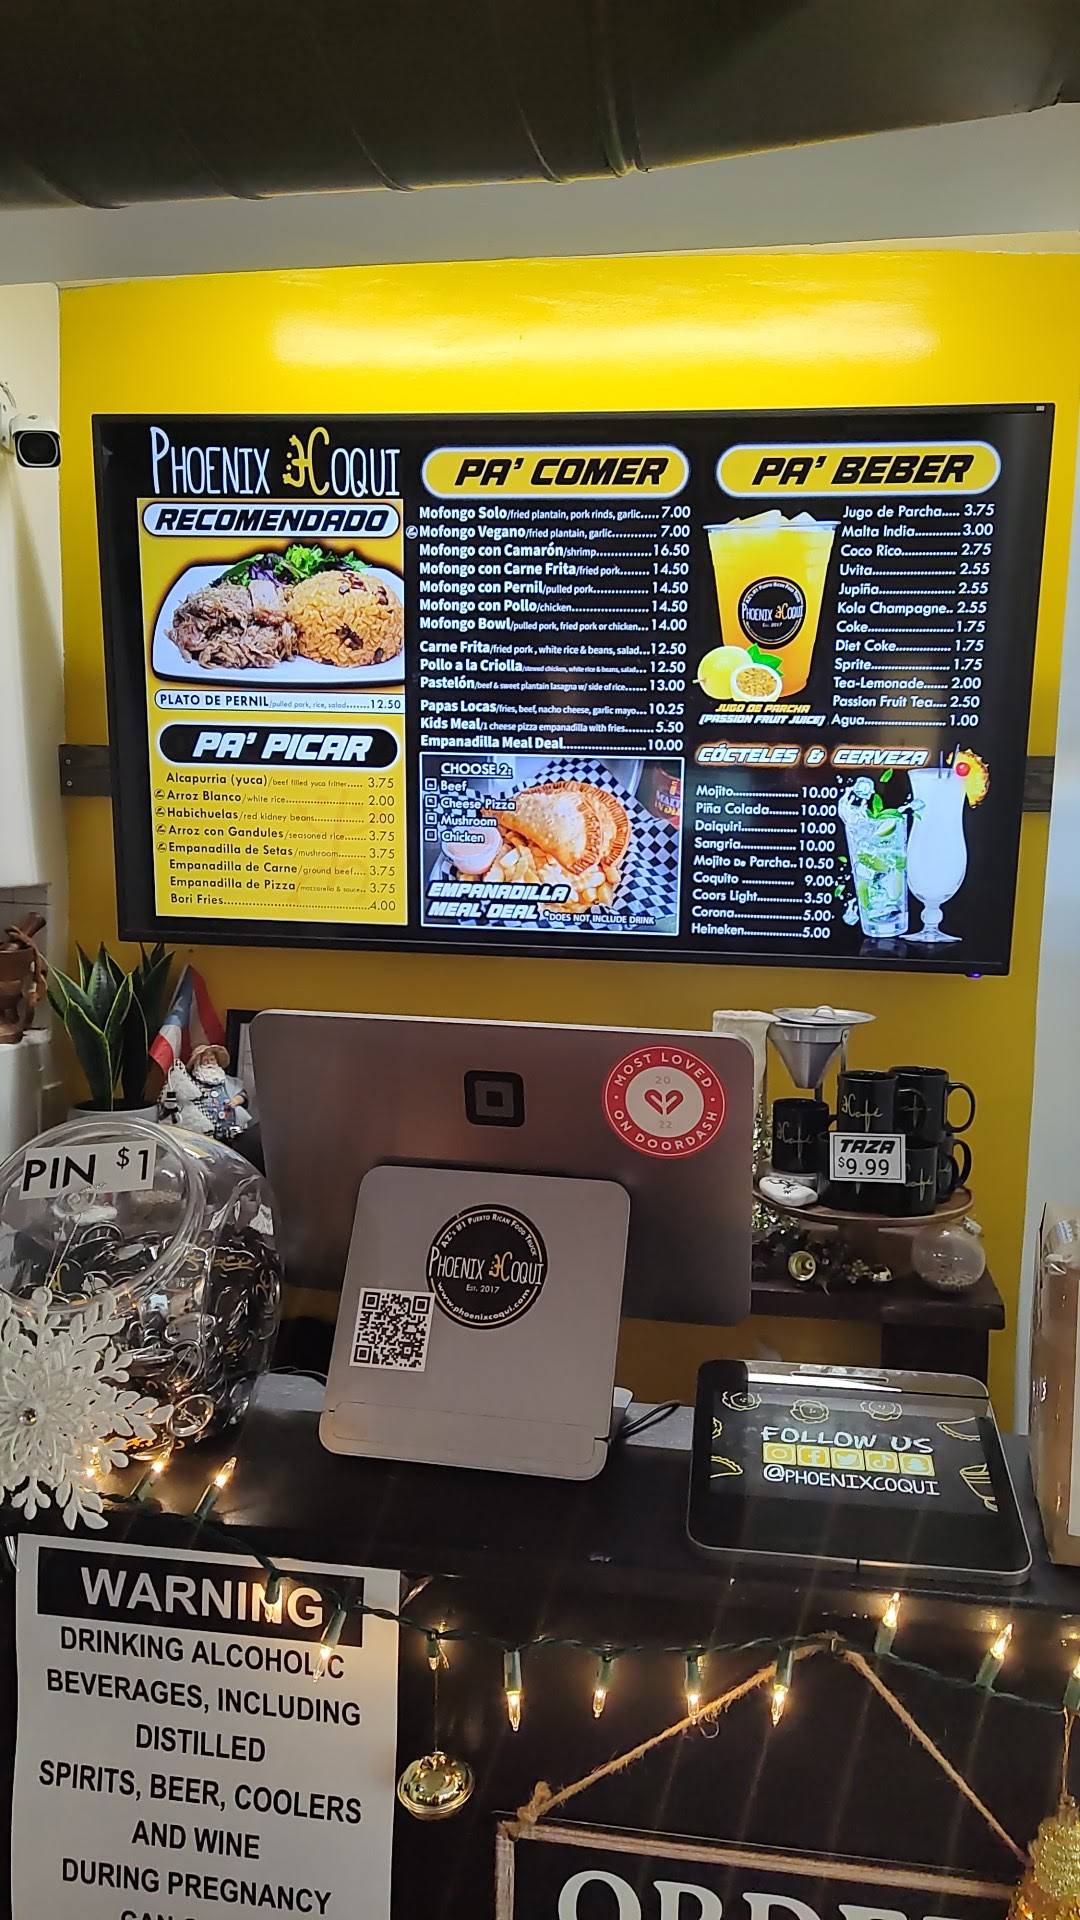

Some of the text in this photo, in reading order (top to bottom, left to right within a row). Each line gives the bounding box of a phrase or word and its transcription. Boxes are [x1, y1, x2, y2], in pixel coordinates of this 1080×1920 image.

[150, 426, 270, 494] PHOENIX
[455, 458, 669, 486] PA' COMER
[752, 455, 974, 485] PA' BEBER
[420, 506, 690, 521] Mofongo plantain, pork rinds, 7.00
[843, 504, 994, 519] Jugo de 3.75
[155, 509, 389, 531] RECOMENDADO
[420, 526, 690, 540] Mofongo plantain, 7.00
[841, 524, 993, 537] Malta 3.00
[420, 544, 501, 558] Mofongo con
[841, 543, 991, 556] Coco 2.75
[420, 563, 688, 577] Mofongo con Carne 14.50
[960, 563, 990, 574] 2.55
[420, 581, 688, 595] Mofongo con 14.50
[958, 582, 988, 594] 2.55
[420, 600, 687, 614] Mofongo con 14.50
[838, 602, 987, 614] Kola 2.55
[420, 617, 687, 631] Mofongo pork, fried pork 14.00
[956, 621, 985, 633] 1.75
[420, 641, 615, 655] Carne white rice beans,
[835, 640, 984, 651] Diet 1.75
[421, 659, 685, 672] Pollo la 12.50
[953, 659, 982, 670] 1.75
[500, 680, 685, 691] sweet plantain lasagna 13.00
[951, 677, 981, 689] 2.00
[160, 695, 221, 705] PLATO DE
[833, 695, 980, 708] Passion Fruit 2.50
[421, 701, 684, 715] Papas nacho cheese, 10.25
[421, 718, 587, 732] Kids cheese pizza empanadilla
[193, 732, 373, 761] PA' PICAR
[421, 735, 683, 750] Empanadilla Meal 10.00
[698, 743, 929, 766] CÓCTELES & CERVEZA
[441, 763, 497, 775] CHOOSE
[166, 773, 394, 788] Alcapurria 3.75
[441, 780, 467, 791] Beef
[167, 791, 394, 806] Arroz 2.00
[802, 787, 837, 799] 10.00
[441, 798, 516, 810] Cheese Pizza
[696, 803, 836, 816] Piña 10.00
[368, 814, 395, 823] 2.00
[441, 815, 497, 826] Mushroom
[169, 826, 395, 841] Arroz con 3.75
[800, 823, 836, 834] 10.00
[442, 831, 484, 842] Chicken
[169, 842, 395, 859] Empanadilla de 3.75
[799, 840, 835, 852] 10.00
[170, 860, 395, 876] Empanadilla de 3.75
[693, 855, 731, 869] Mojito
[170, 877, 242, 891] Empanadilla
[247, 879, 259, 889] de
[370, 884, 396, 893] 3.75
[693, 873, 834, 887] Coquito 9.00
[428, 882, 569, 901] EMPANADILLA
[692, 890, 726, 901] Coors
[171, 894, 193, 904] Bori
[429, 903, 537, 920] MEAL DEAL
[573, 914, 654, 924] NOT INCLUDE DRINK
[614, 1053, 711, 1087] MOST LOVED
[614, 1111, 717, 1150] ON DOORDASH
[841, 1140, 895, 1154] TAZA
[23, 1146, 148, 1191] PIN $1
[838, 1157, 889, 1176] $9.99
[429, 1246, 485, 1280] PHOENIX
[480, 1285, 499, 1293] 2017
[438, 1282, 530, 1320] www.phoenixcoqui.com
[761, 1426, 934, 1453] FOLLOW US
[763, 1464, 940, 1496] @PHOENIXCOQUI
[81, 1567, 323, 1628] WARNING
[61, 1626, 183, 1661] DRINKING
[47, 1669, 360, 1726] BEVERAGES, INCLUDING
[136, 1724, 265, 1762] DISTILLED
[39, 1760, 362, 1824] SPIRITS, BEER, COOLERS
[132, 1820, 260, 1859] AND WINE
[62, 1858, 331, 1915] DURING PREGNANCY
